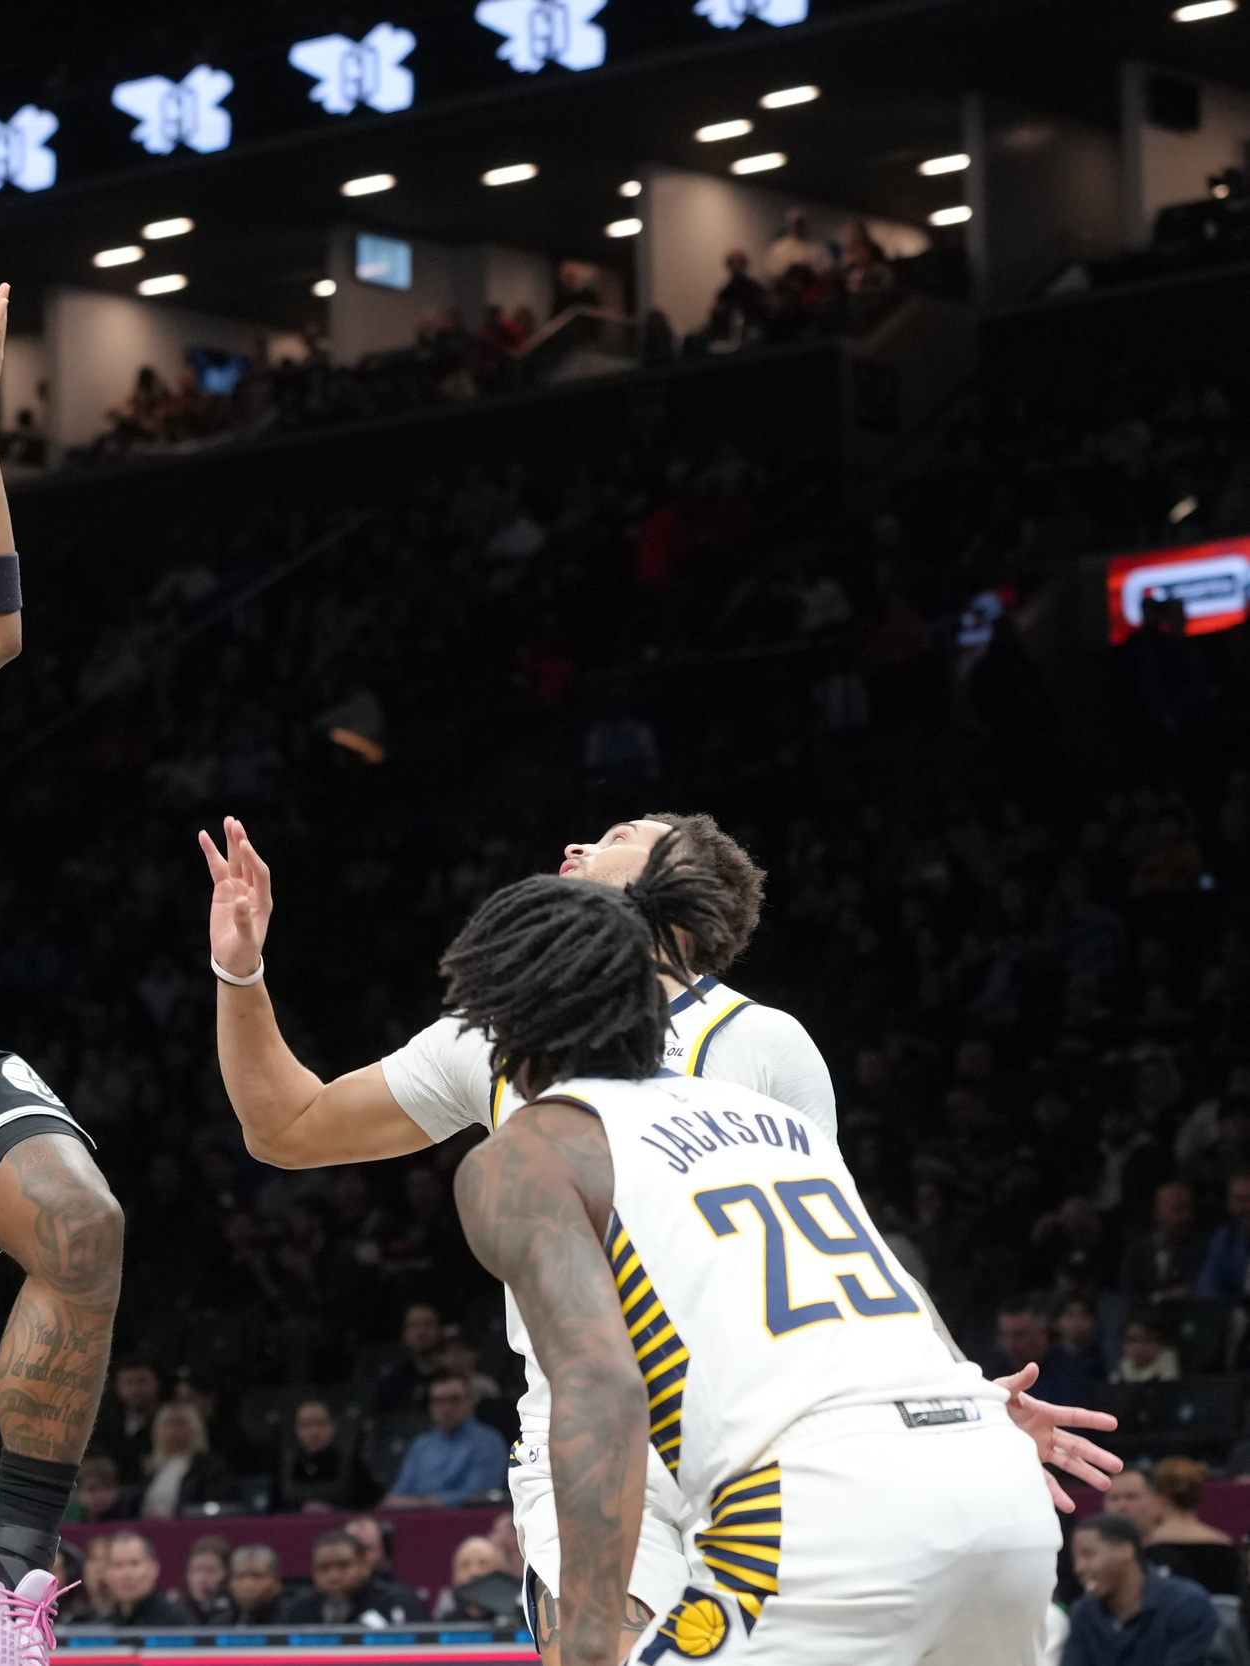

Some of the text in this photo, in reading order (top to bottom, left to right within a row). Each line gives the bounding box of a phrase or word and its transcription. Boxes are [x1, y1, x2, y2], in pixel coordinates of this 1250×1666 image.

[666, 1047, 684, 1057] OIL
[641, 1110, 811, 1174] JACKSON
[692, 1178, 921, 1341] 29
